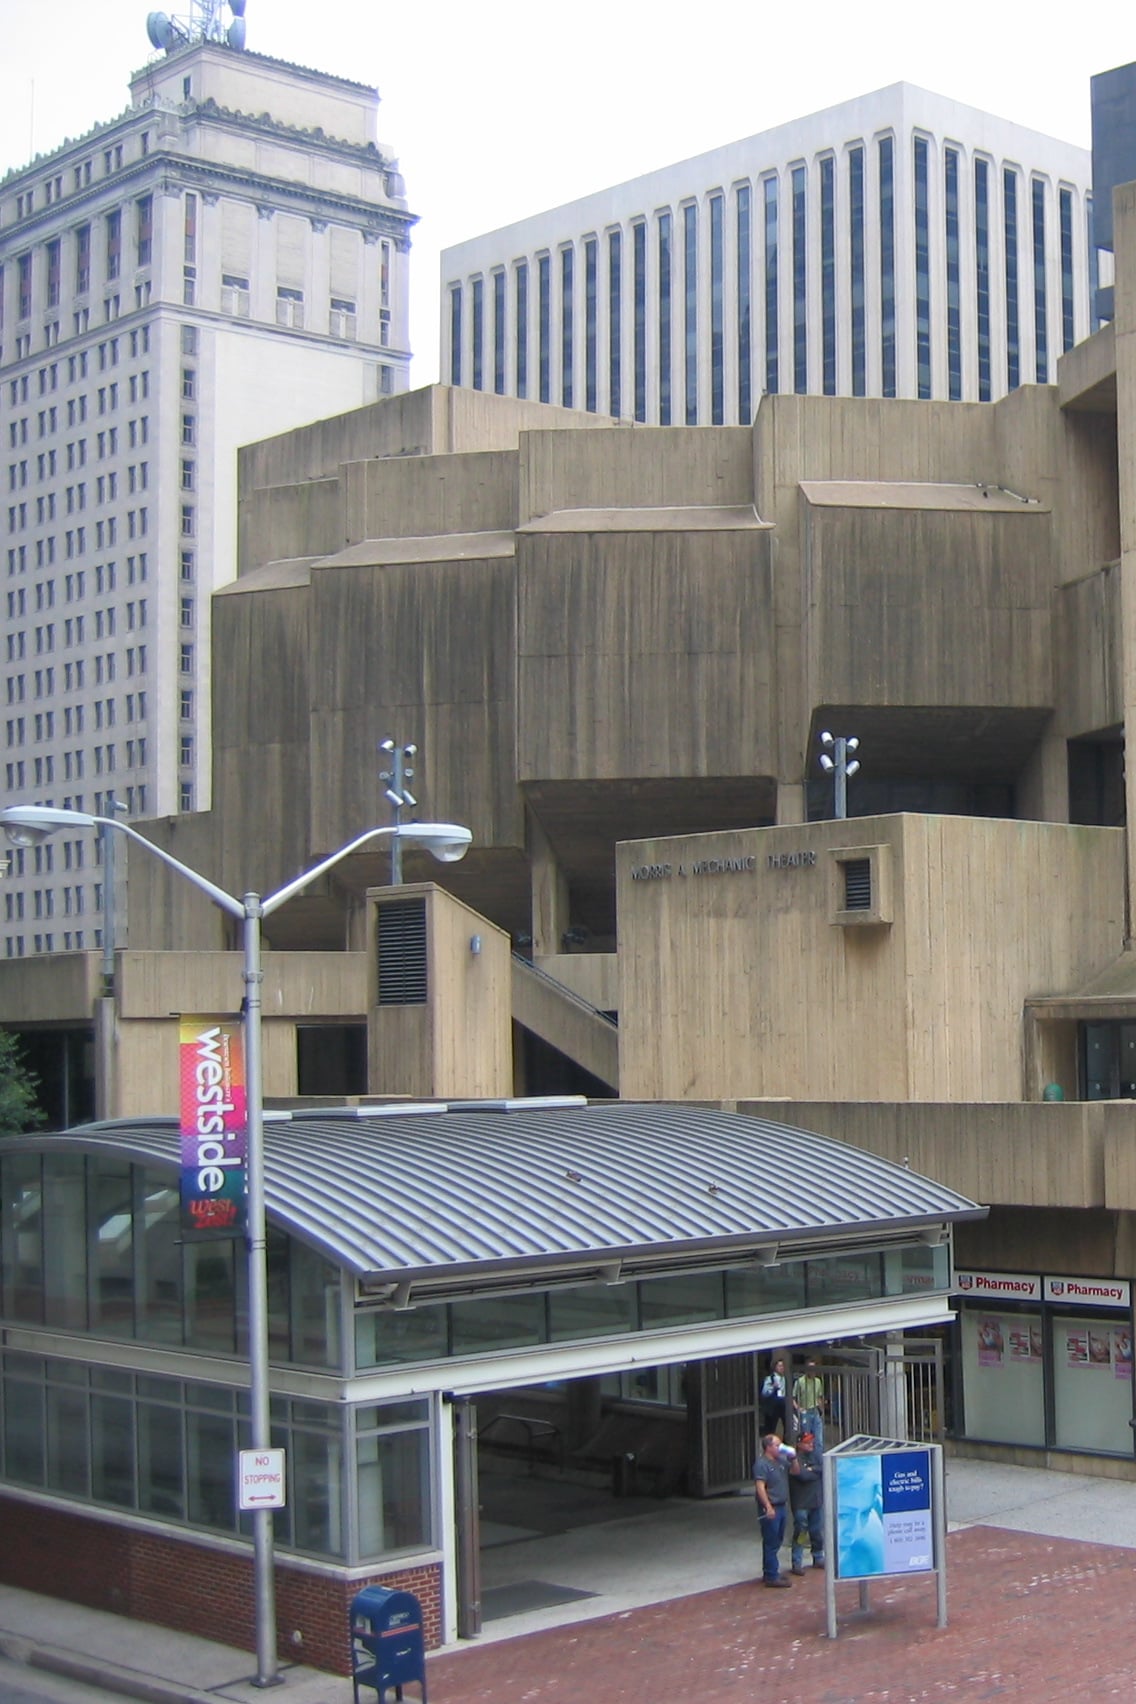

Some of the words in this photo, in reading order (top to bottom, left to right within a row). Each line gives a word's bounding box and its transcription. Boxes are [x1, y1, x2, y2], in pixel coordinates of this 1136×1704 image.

[692, 855, 756, 876] MECHANIC
[195, 1026, 242, 1193] westside
[975, 1277, 1035, 1294] Pharmacy
[1066, 1283, 1123, 1300] Pharmacy
[255, 1456, 270, 1466] NO
[244, 1473, 281, 1485] STOPPING
